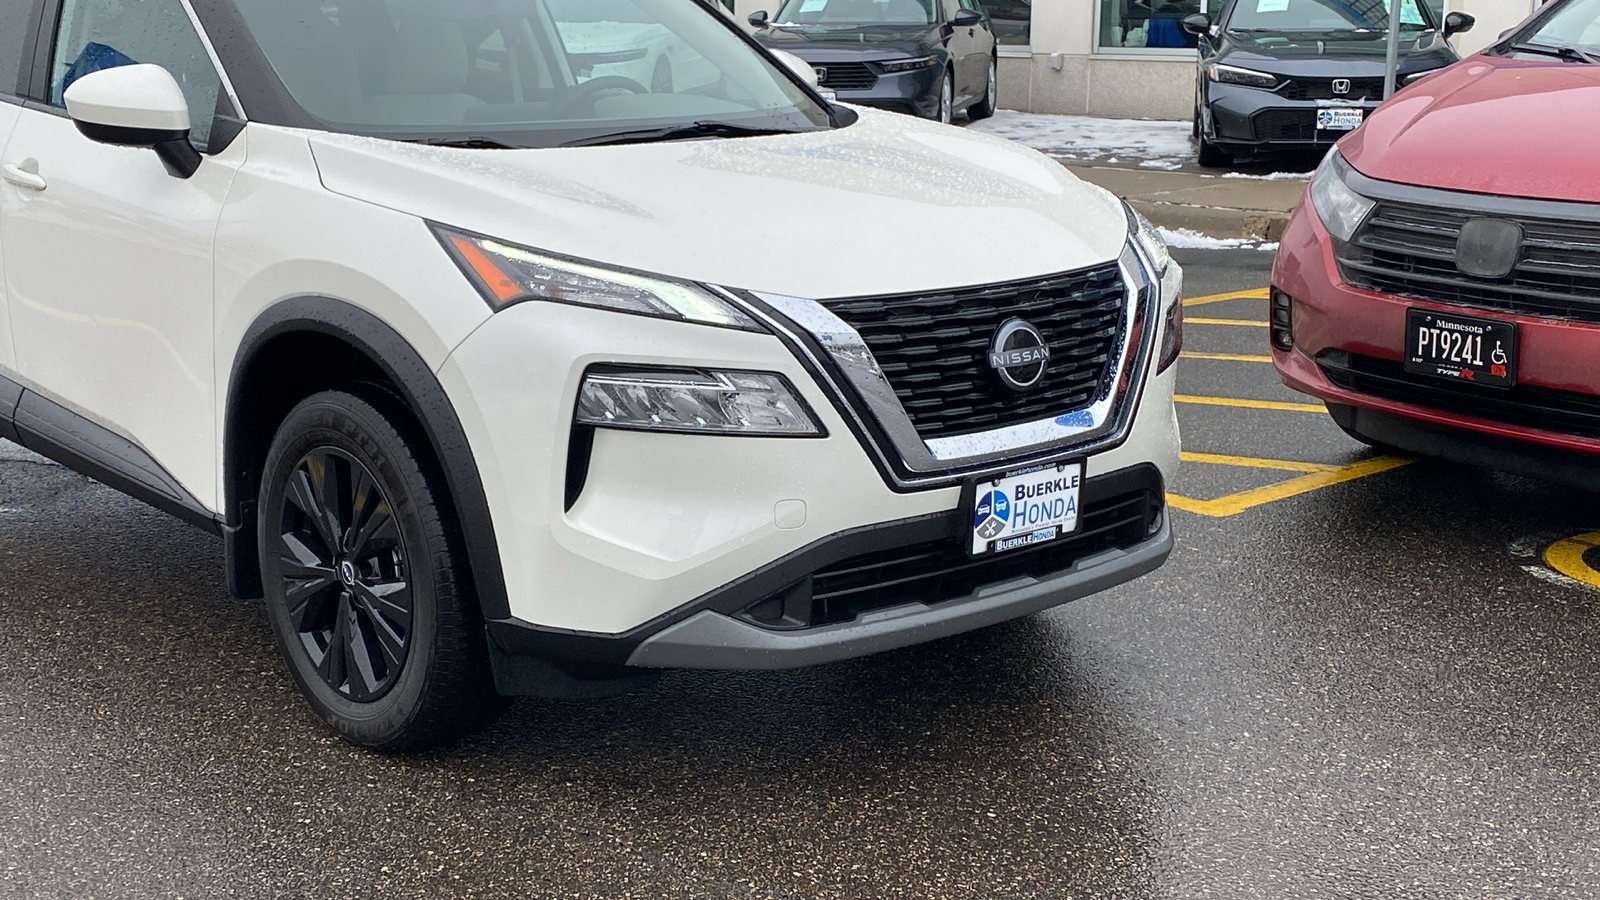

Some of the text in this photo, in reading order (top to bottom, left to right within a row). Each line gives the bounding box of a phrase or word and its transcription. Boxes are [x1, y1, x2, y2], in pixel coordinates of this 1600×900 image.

[1334, 116, 1361, 124] HONDA
[1436, 320, 1483, 334] Minnesota
[992, 348, 1048, 366] NISSAN
[1418, 327, 1483, 366] PT9241
[1014, 475, 1079, 501] BUERKLE
[1012, 495, 1076, 529] HONDA
